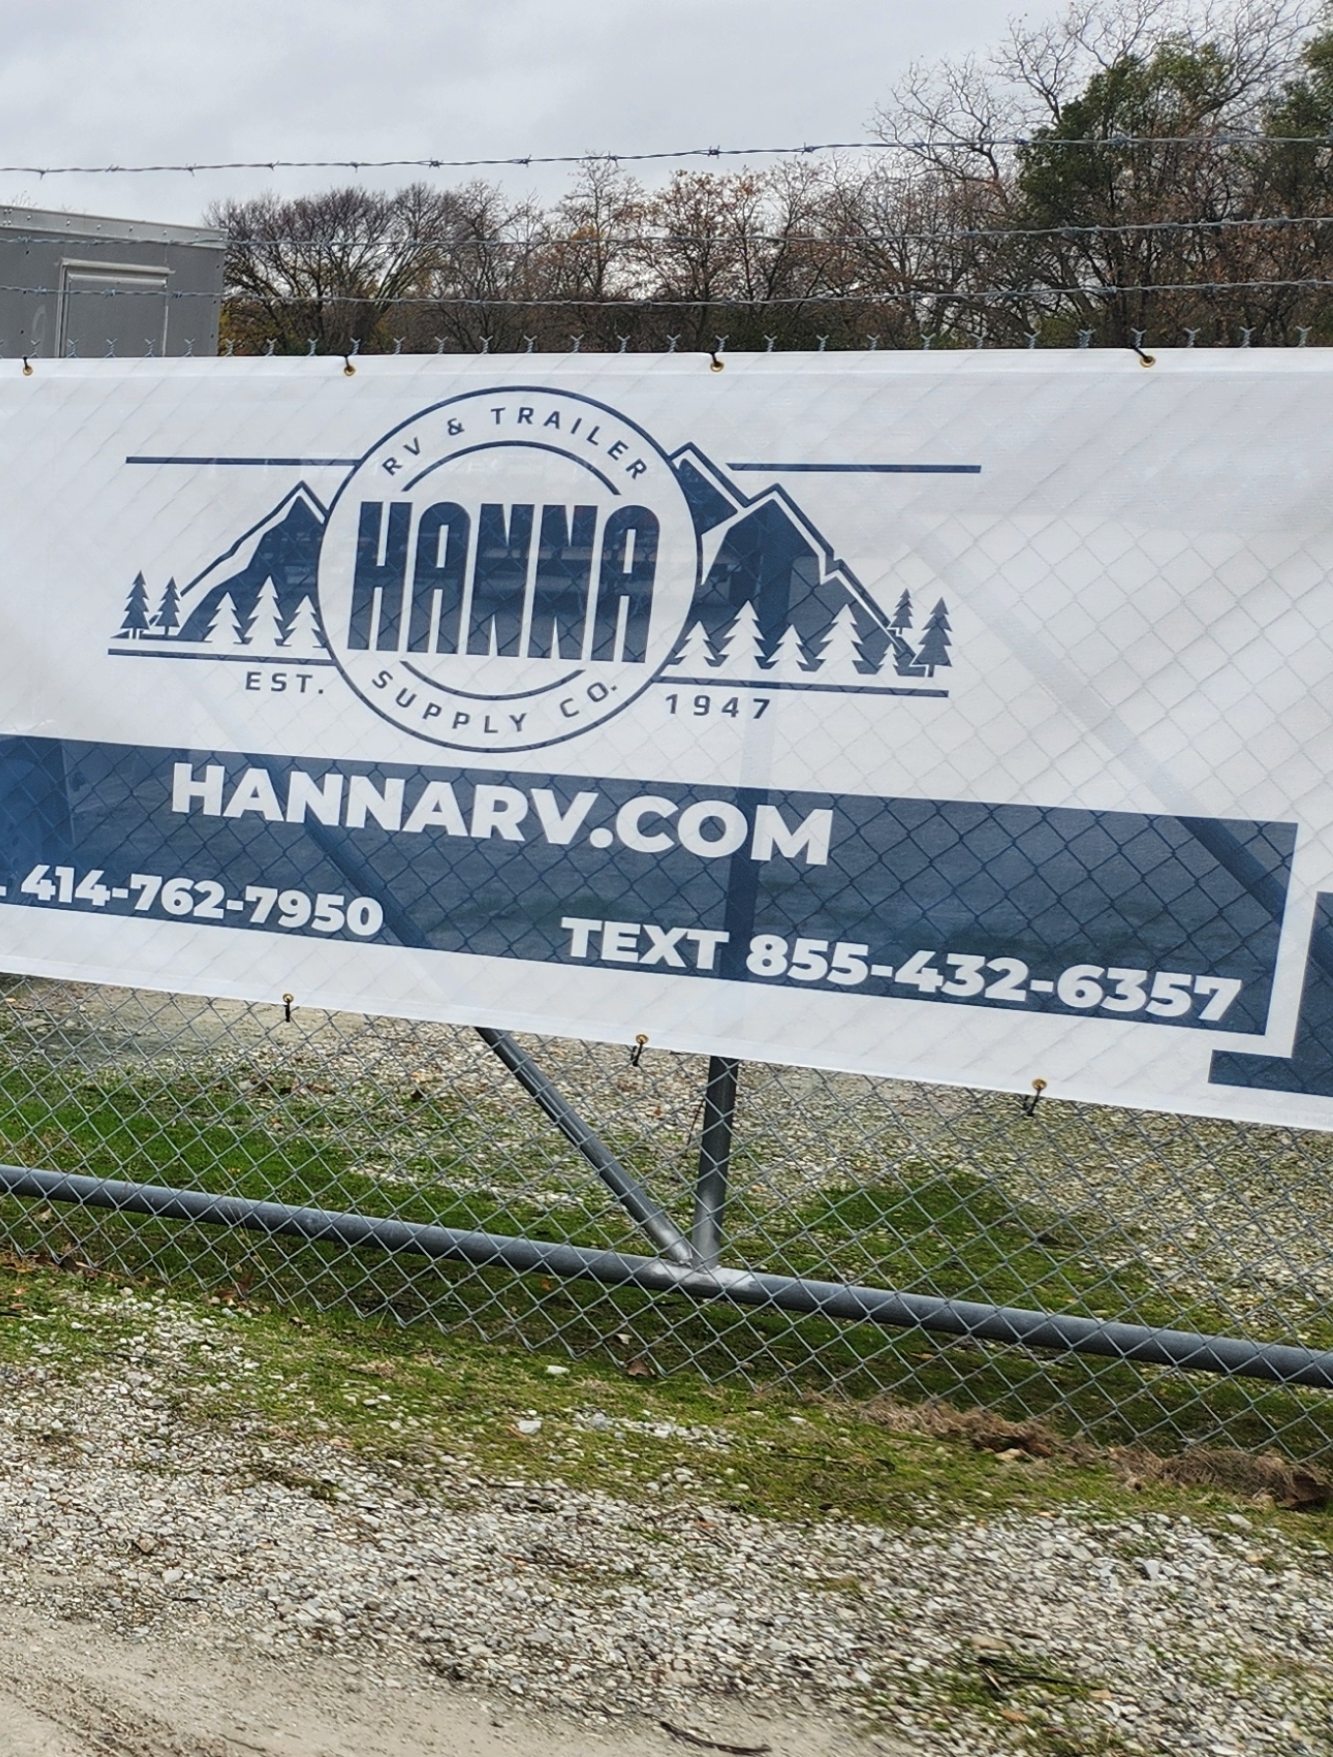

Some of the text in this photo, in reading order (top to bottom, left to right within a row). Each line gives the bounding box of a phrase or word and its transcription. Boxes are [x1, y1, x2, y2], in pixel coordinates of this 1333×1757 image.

[380, 405, 648, 480] RV & TRAILER
[346, 500, 661, 664] HANNA
[244, 670, 326, 695] EST.
[370, 668, 619, 735] SUPPLY CO.
[664, 692, 772, 721] 1947
[170, 761, 834, 867] HANNARV.COM
[19, 863, 385, 938] 414-762-7950
[559, 915, 1243, 1022] TEXT 855-432-6357
